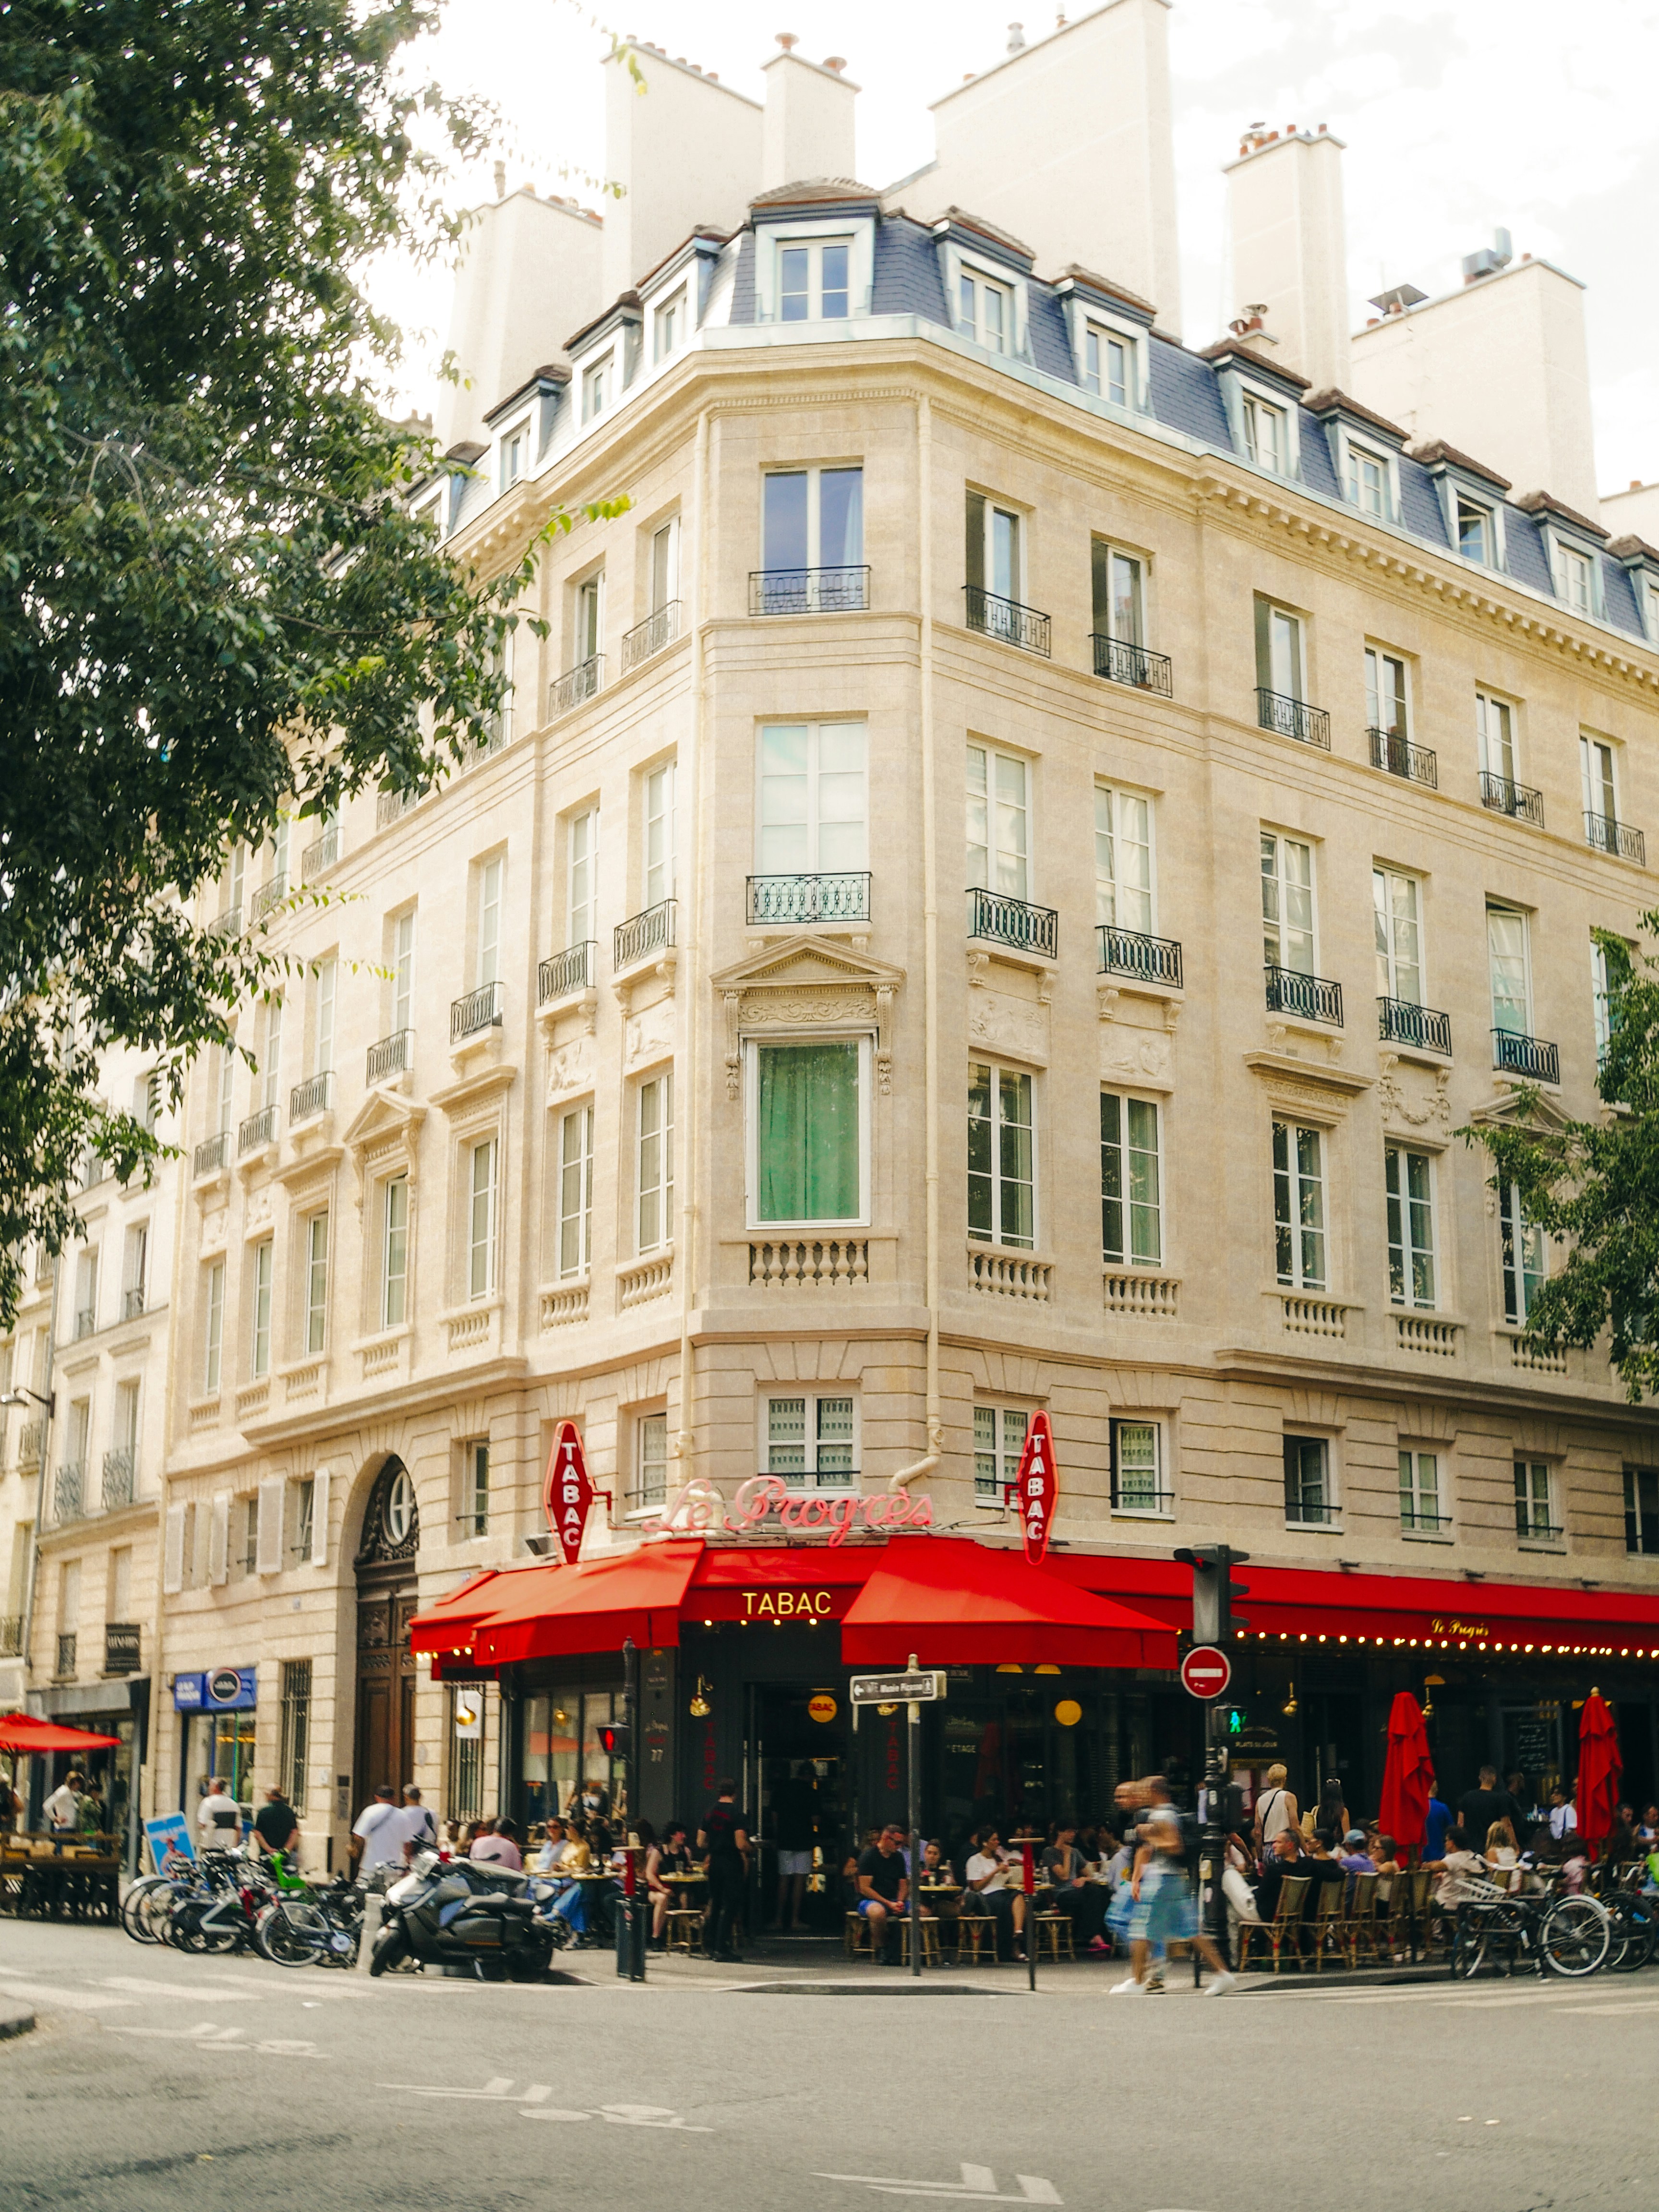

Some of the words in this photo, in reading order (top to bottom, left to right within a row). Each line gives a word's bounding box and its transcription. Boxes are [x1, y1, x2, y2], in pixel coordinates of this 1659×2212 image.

[561, 1443, 581, 1546] TABAC
[642, 1478, 712, 1532] Le
[723, 1475, 935, 1548] Progrès
[1027, 1434, 1046, 1539] TABAC
[742, 1591, 831, 1615] TABAC
[1431, 1618, 1445, 1634] Le
[1448, 1619, 1489, 1639] Progrès
[704, 1722, 716, 1790] TABAC
[887, 1721, 899, 1789] TABAC
